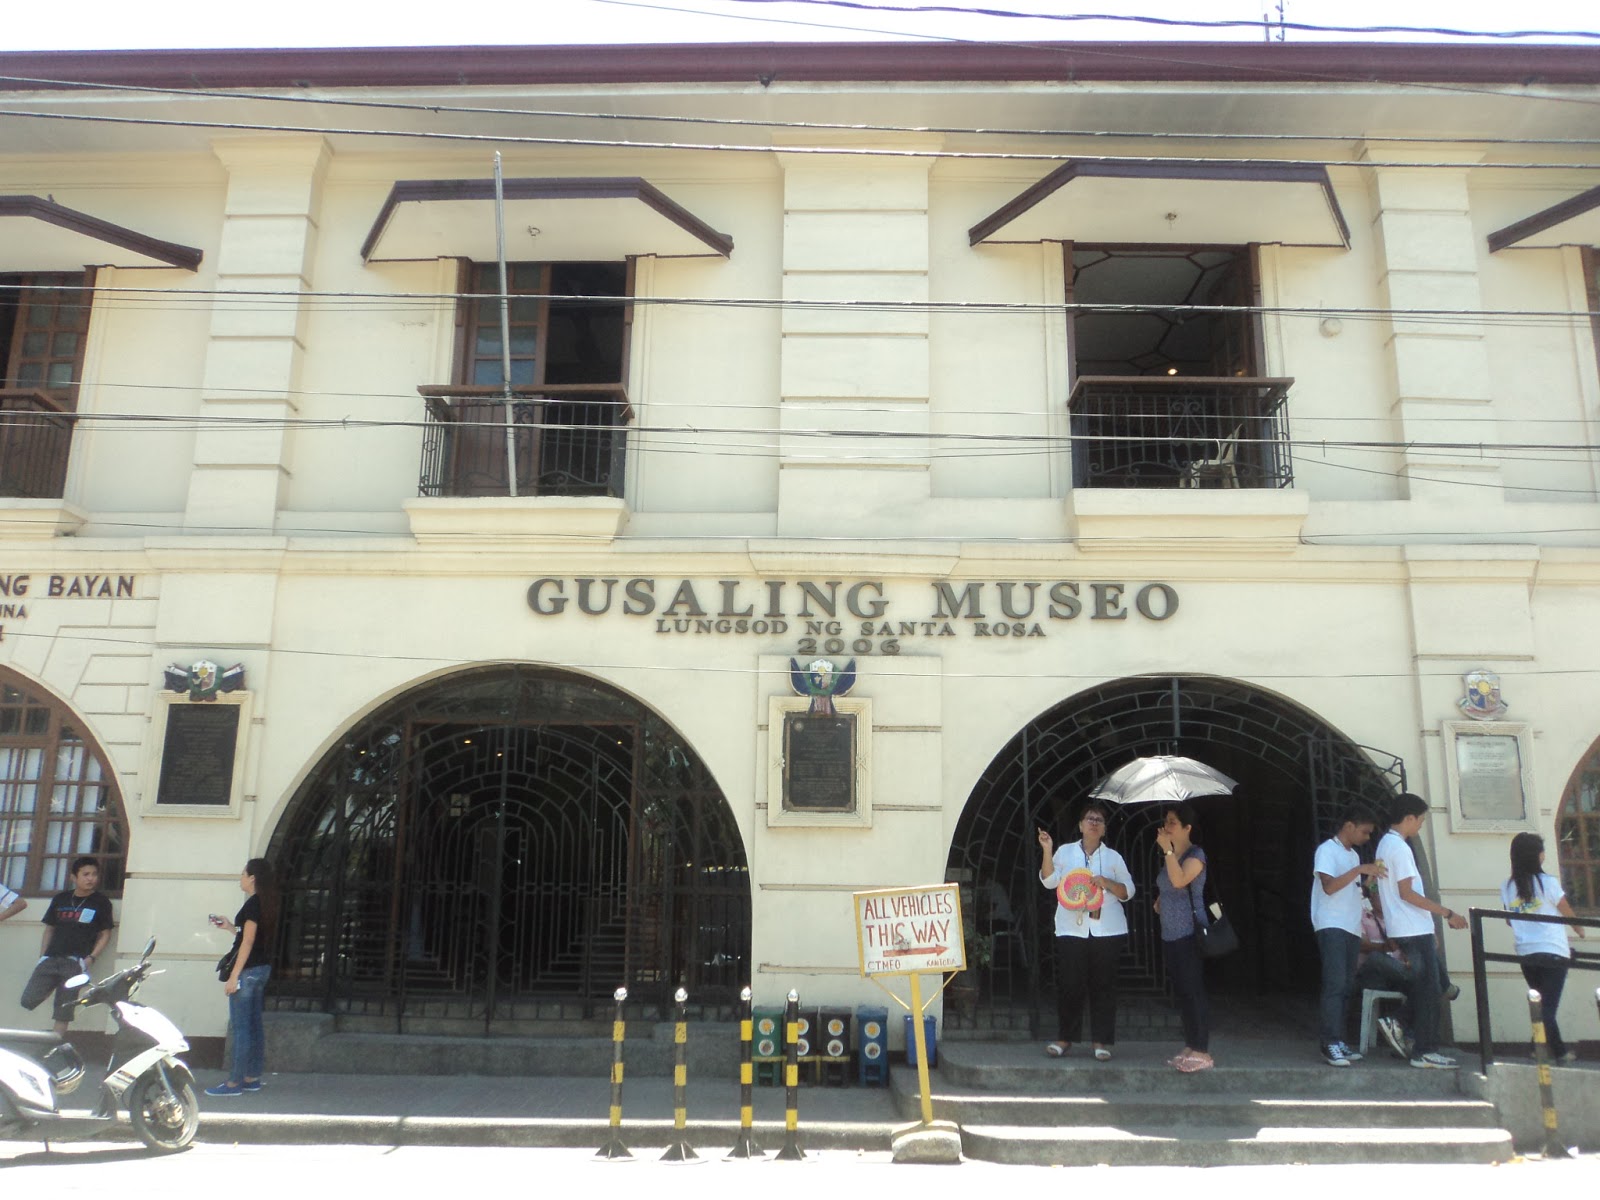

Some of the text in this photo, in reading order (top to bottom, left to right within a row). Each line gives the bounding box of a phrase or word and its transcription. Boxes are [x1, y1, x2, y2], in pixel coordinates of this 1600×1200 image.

[48, 575, 134, 597] BAYAN
[526, 578, 1180, 620] GUSALING MUSEO
[655, 619, 1046, 637] LUNGSOD NG SANTA ROSA
[797, 637, 900, 655] 2006
[864, 893, 953, 920] ALL VEHICLES
[865, 919, 950, 947] THIS WAY
